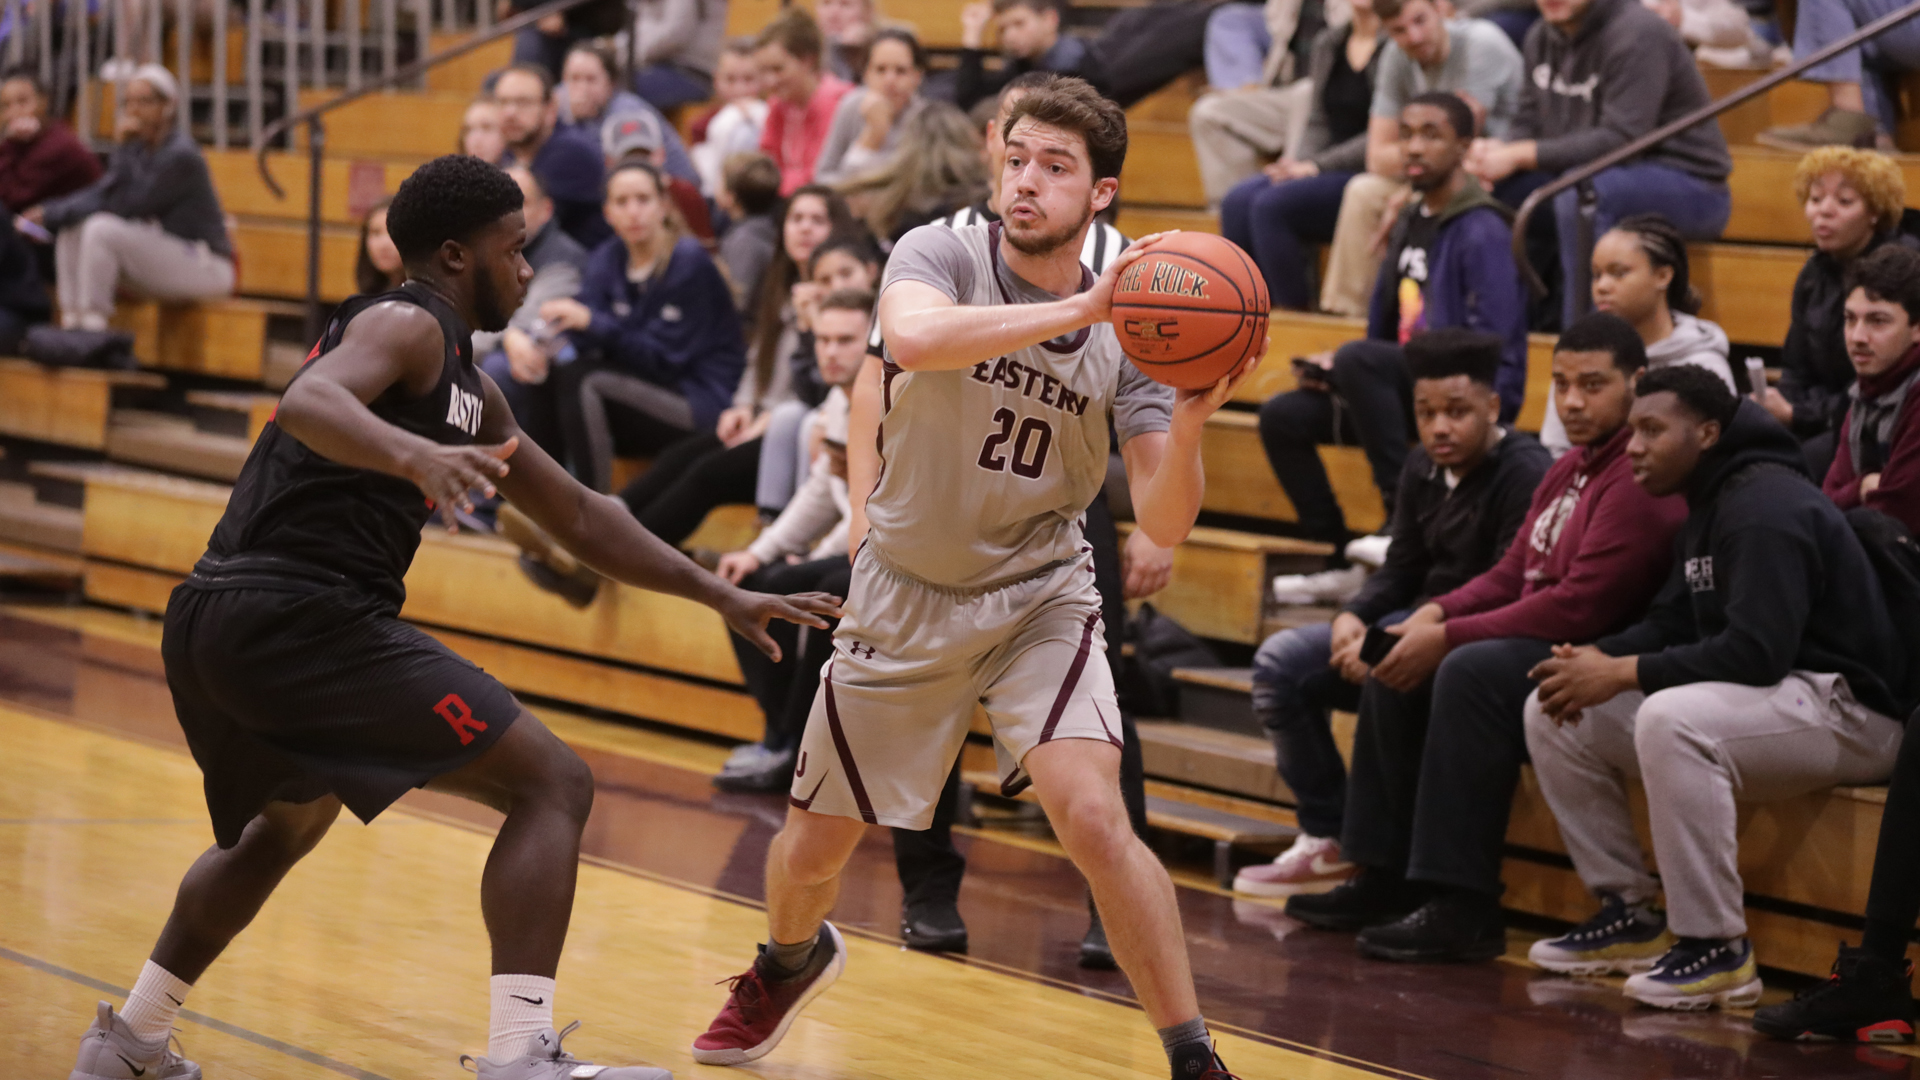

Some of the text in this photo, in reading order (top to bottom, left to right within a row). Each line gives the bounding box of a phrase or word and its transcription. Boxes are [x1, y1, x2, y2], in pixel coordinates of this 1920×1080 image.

[1149, 261, 1208, 299] ROCK
[976, 406, 1054, 480] 20
[432, 693, 489, 746] R
